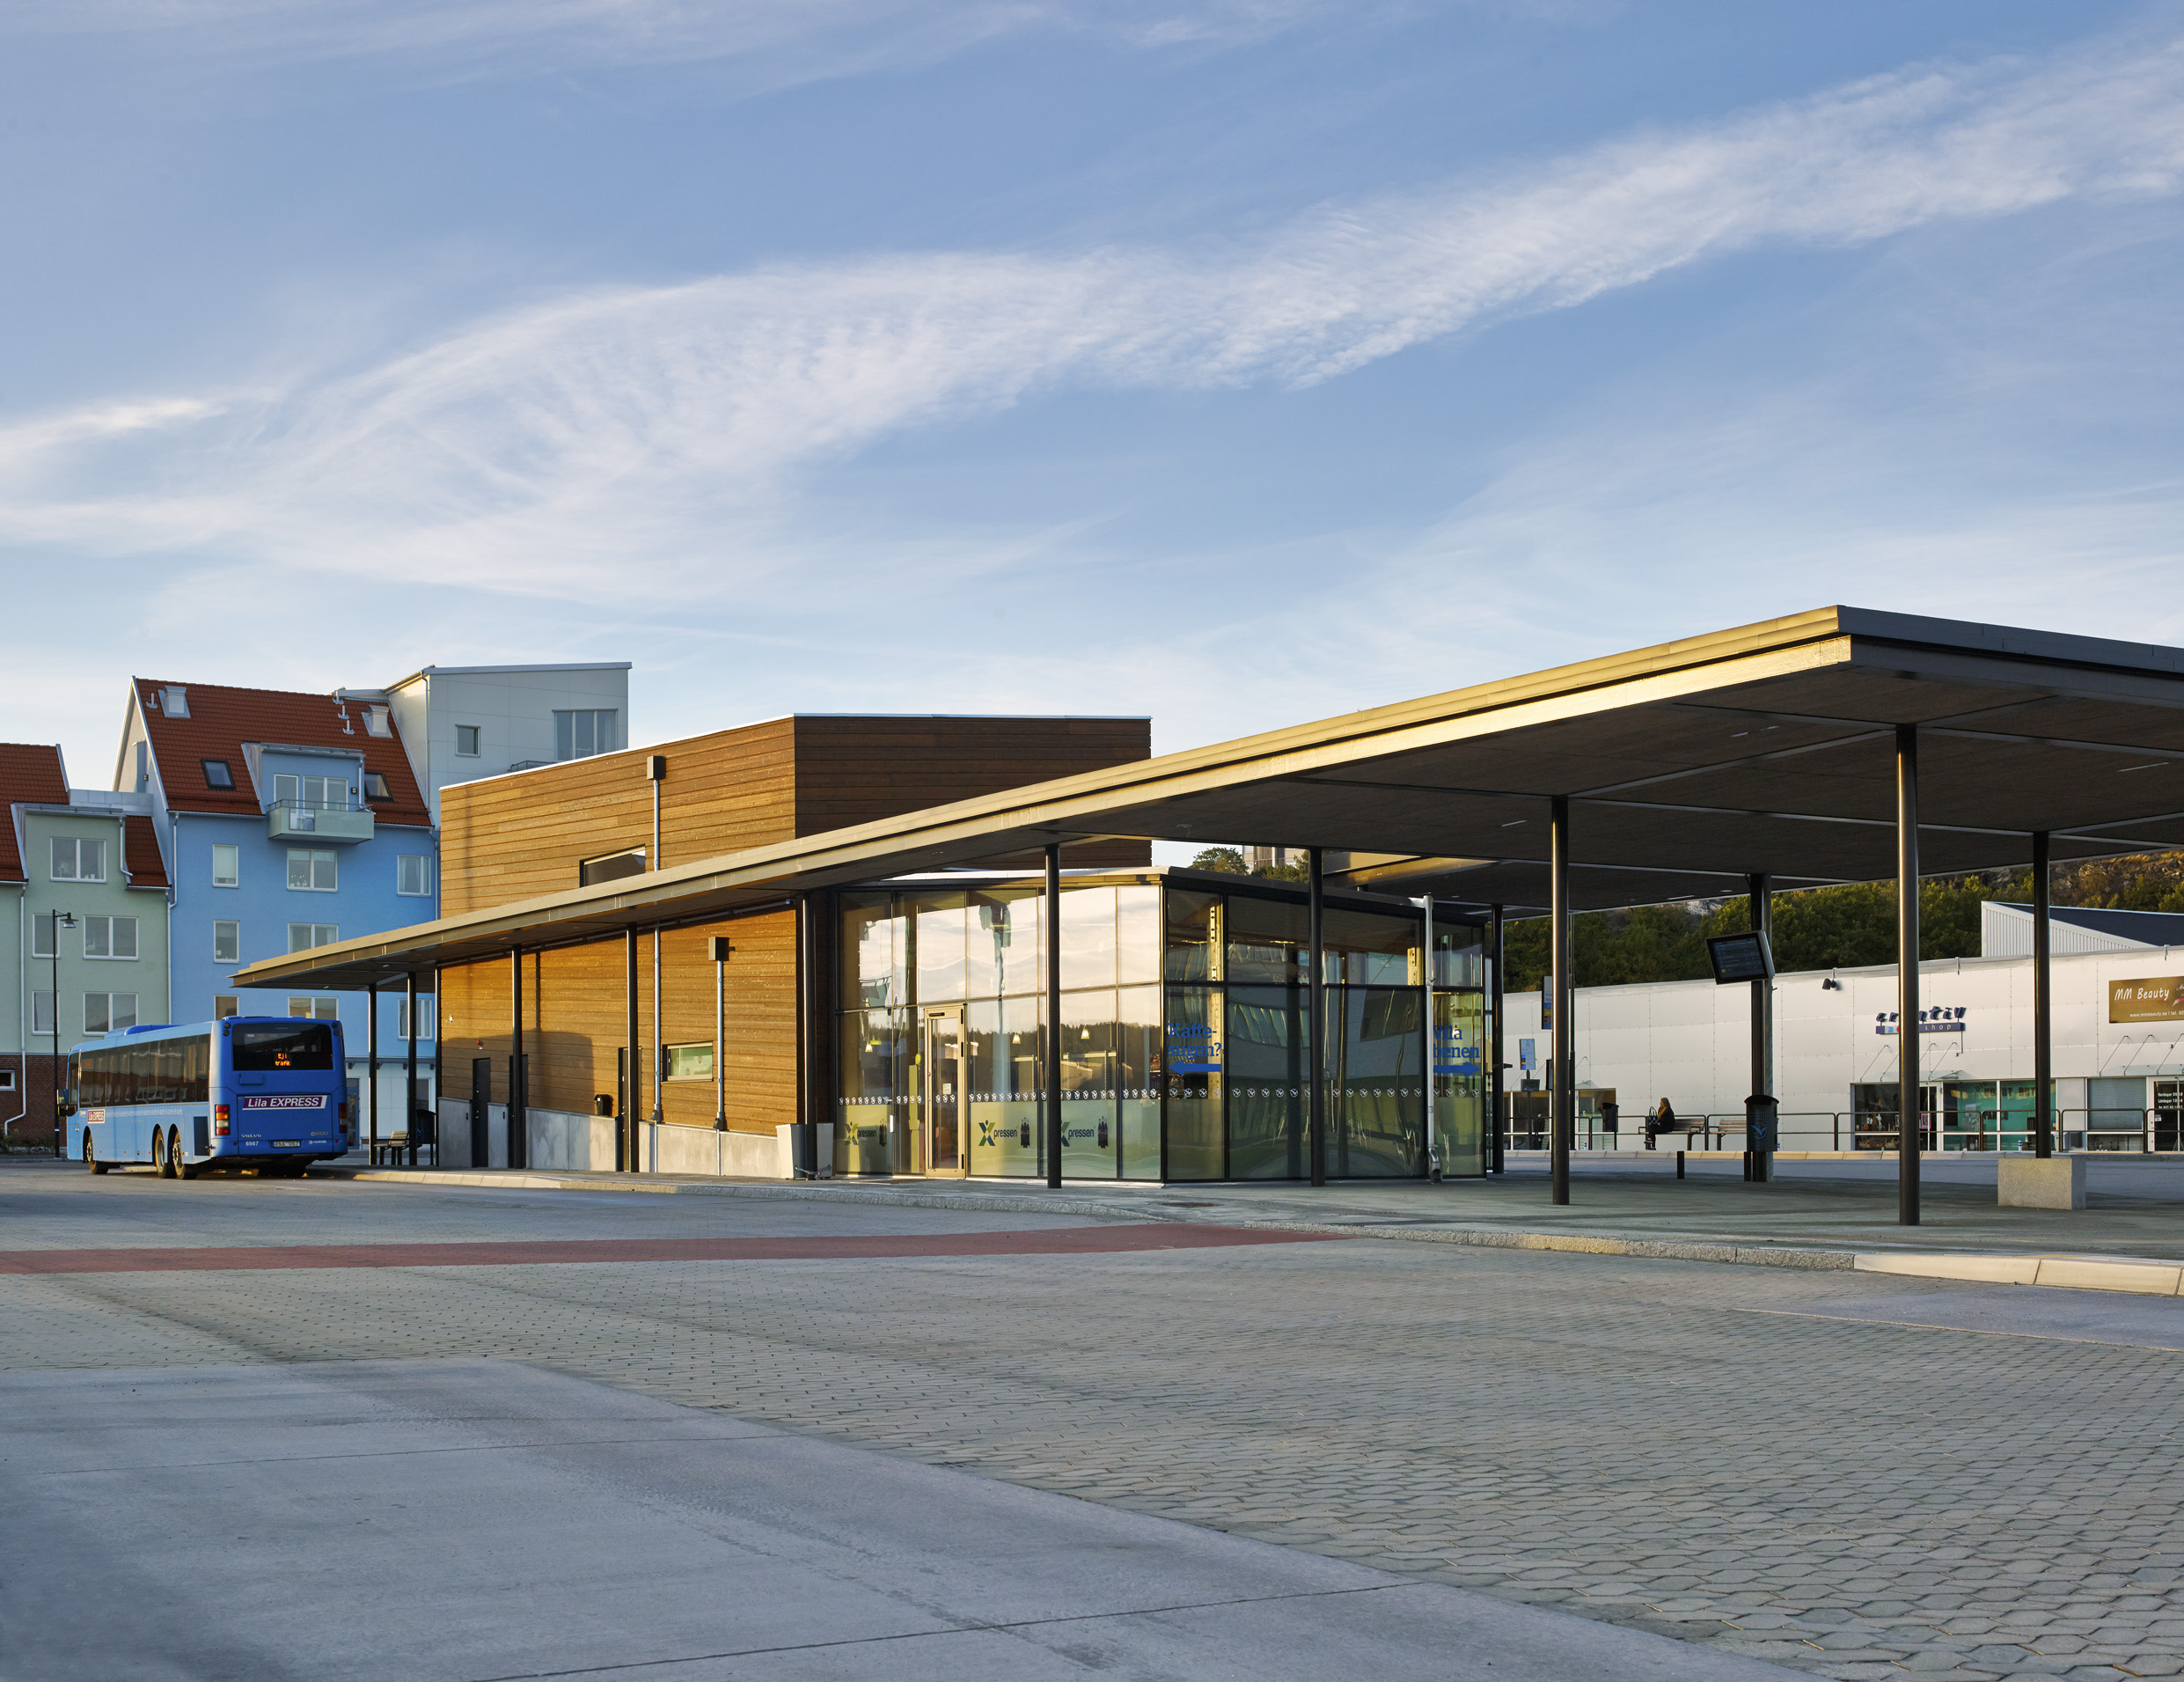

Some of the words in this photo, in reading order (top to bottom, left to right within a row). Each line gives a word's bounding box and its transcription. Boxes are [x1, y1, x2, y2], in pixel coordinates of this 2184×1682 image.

[2114, 988, 2132, 1001] MM
[2137, 988, 2169, 1002] Beauty
[1876, 1006, 1966, 1022] crtiv
[1168, 1023, 1217, 1039] Kaffe-
[1433, 1025, 1462, 1039] Vila
[1168, 1042, 1221, 1060] sugen?
[1433, 1044, 1480, 1058] benen
[247, 1098, 267, 1107] Lila
[270, 1098, 319, 1106] EXPRESS
